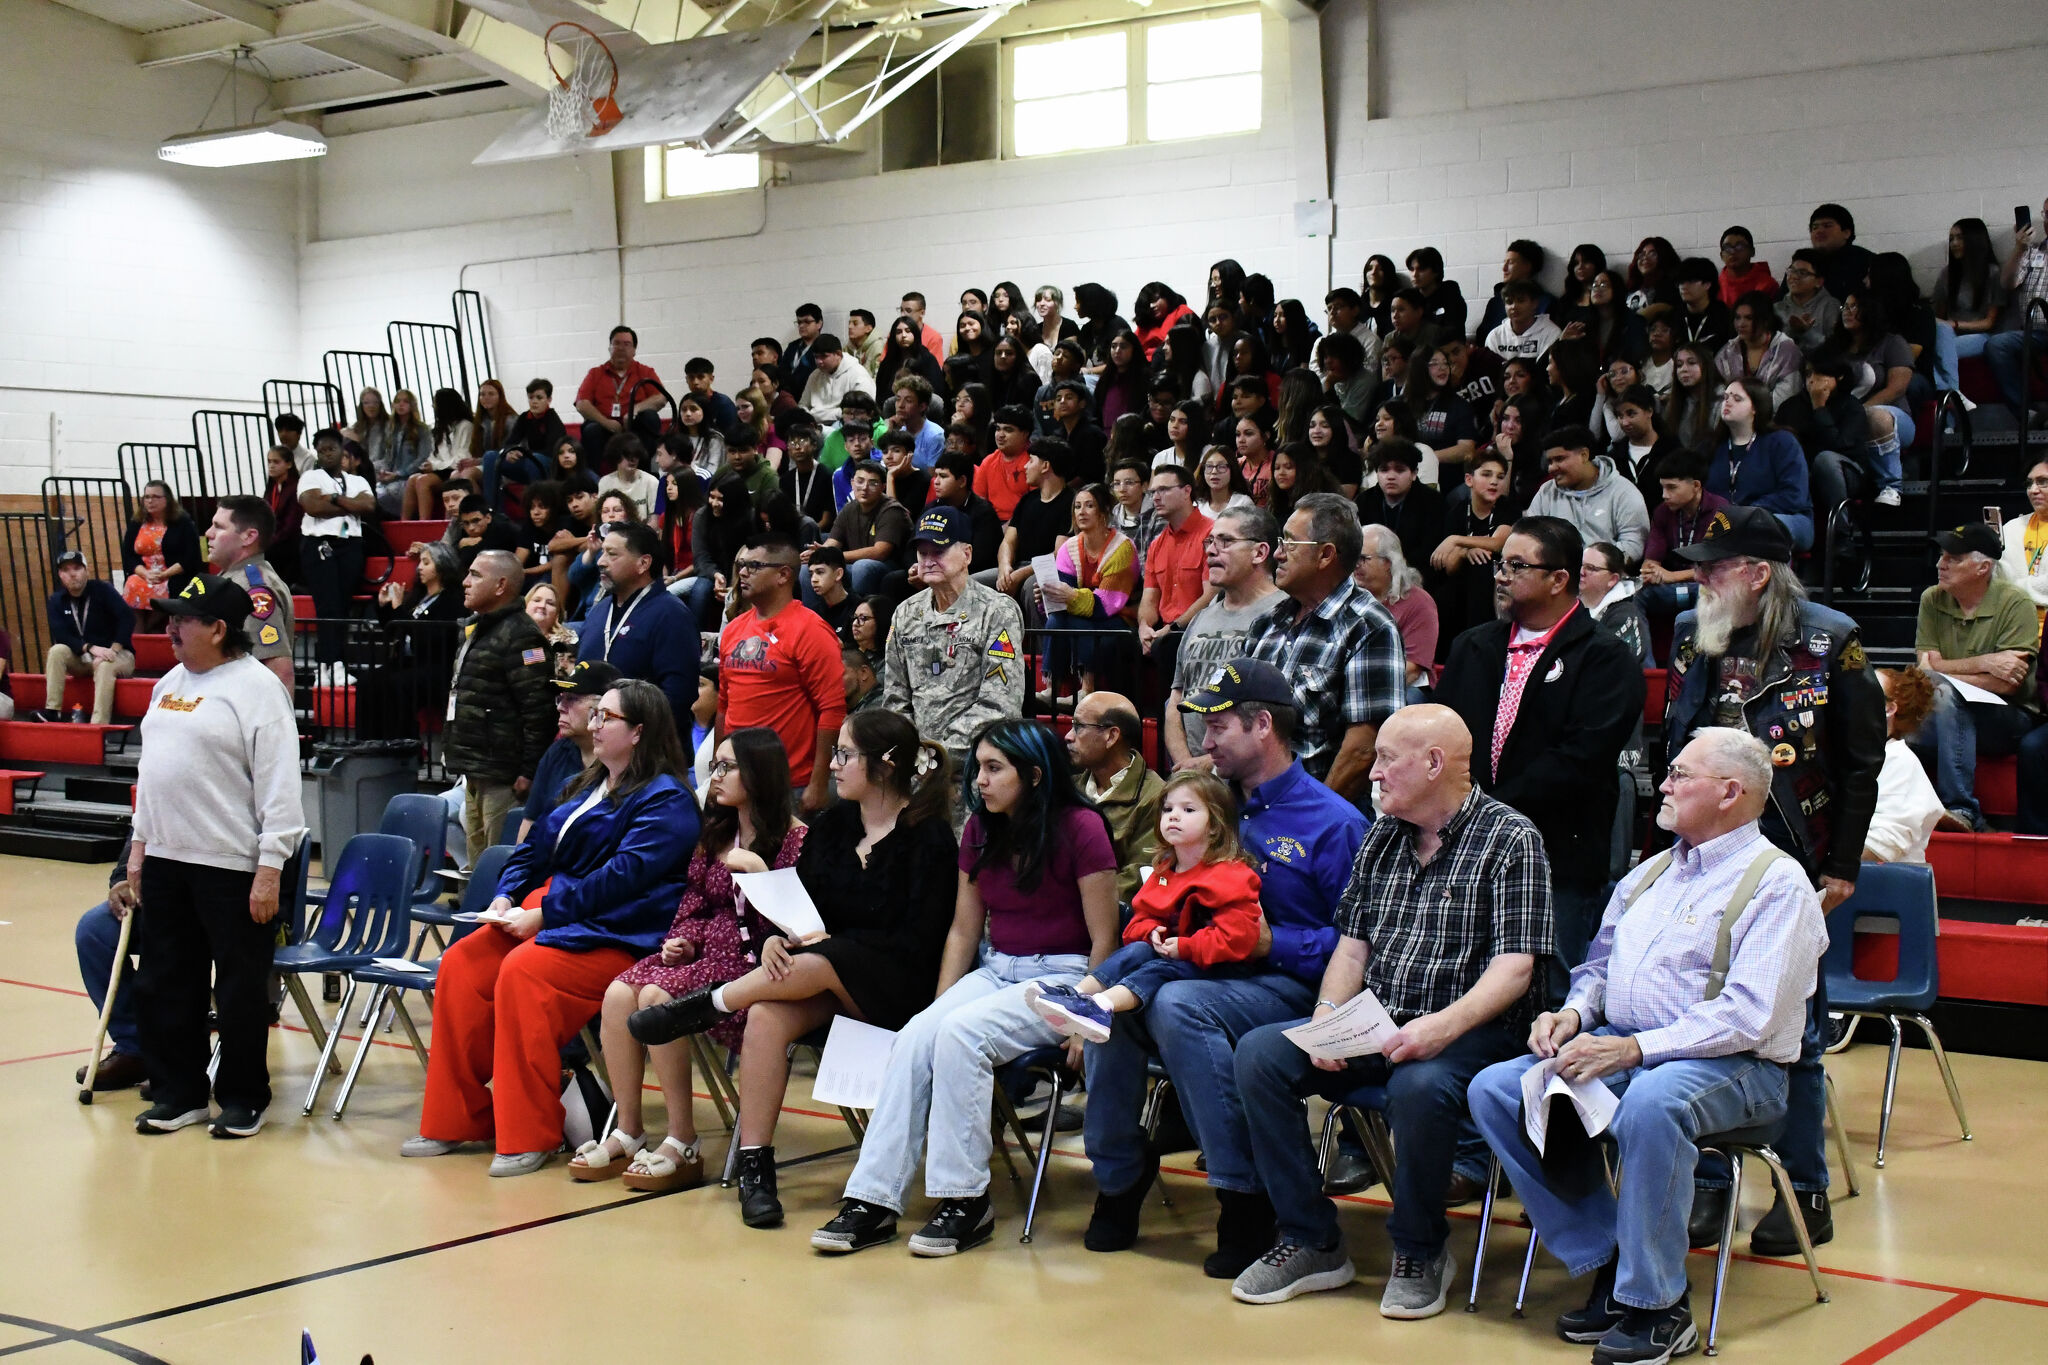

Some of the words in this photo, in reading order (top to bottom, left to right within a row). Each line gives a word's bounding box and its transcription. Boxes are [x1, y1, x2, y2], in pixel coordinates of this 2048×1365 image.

[920, 513, 948, 526] KOREA
[1210, 700, 1234, 712] SERVED
[1277, 836, 1295, 844] COAST
[1294, 841, 1306, 858] GUARD
[1270, 850, 1292, 863] RETIRED
[1353, 1022, 1380, 1039] Program
